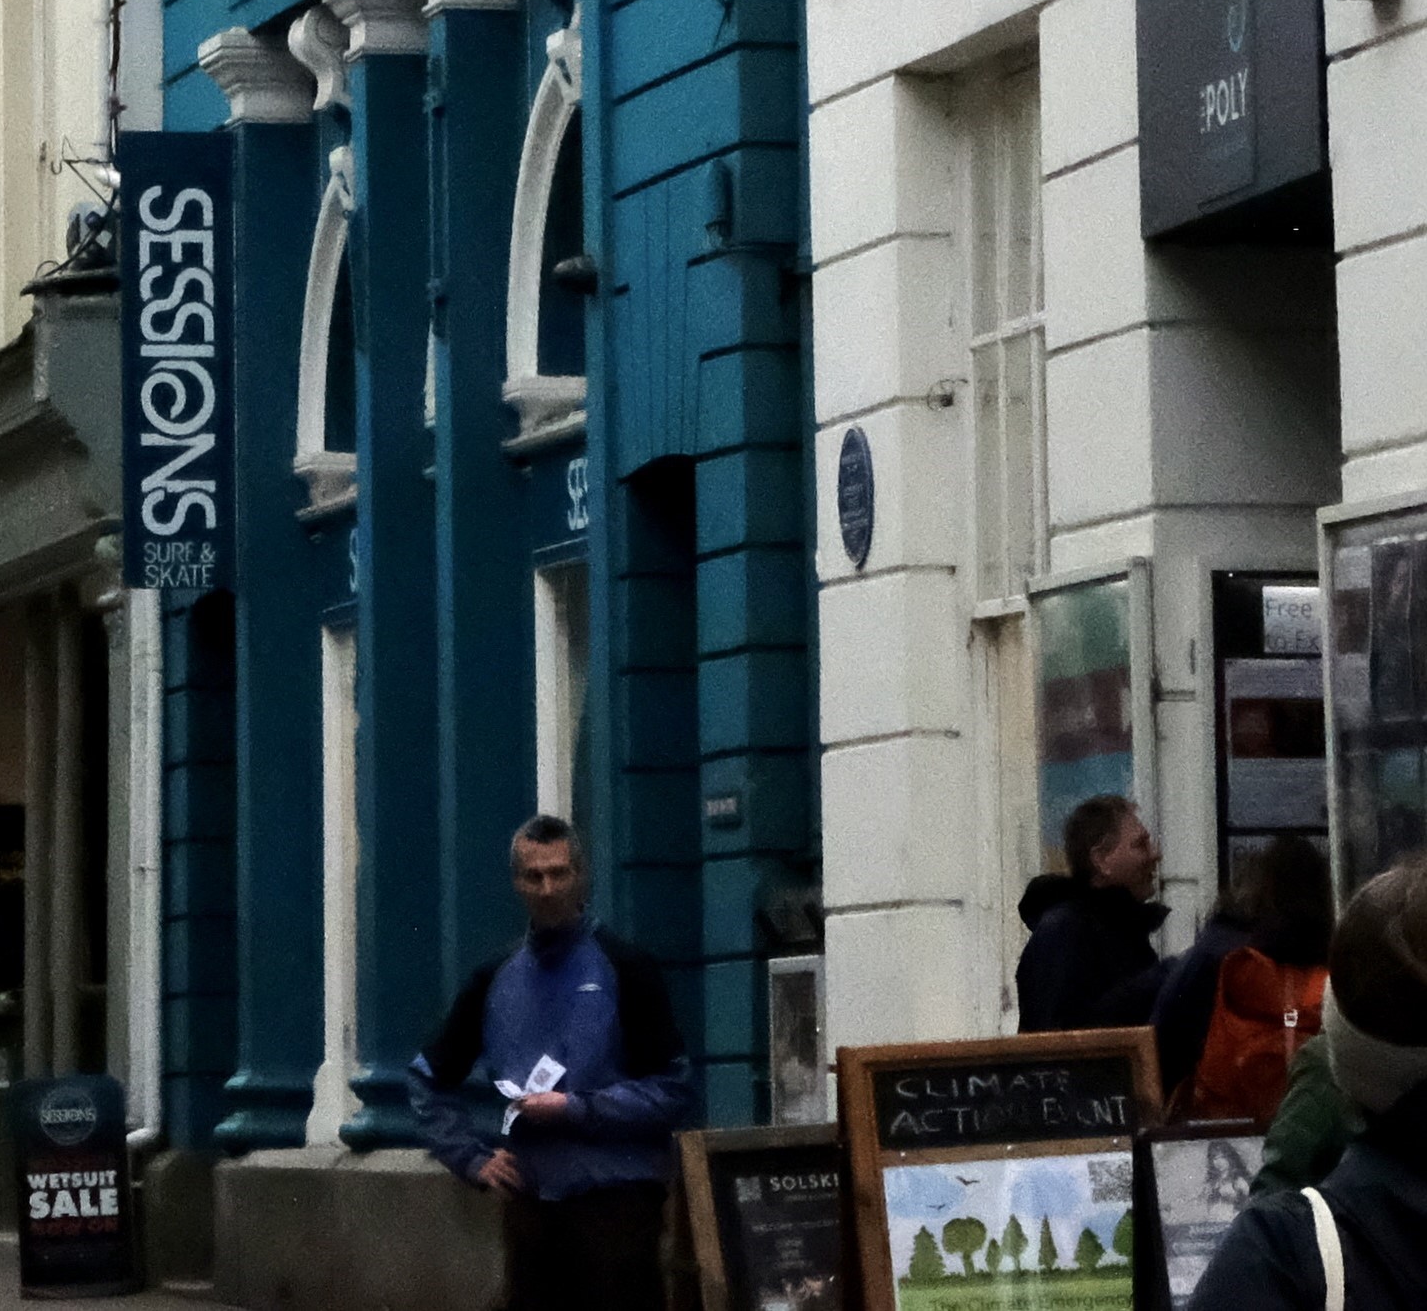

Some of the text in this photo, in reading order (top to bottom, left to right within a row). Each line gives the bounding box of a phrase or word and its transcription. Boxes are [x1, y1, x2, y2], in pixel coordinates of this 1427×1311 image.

[1205, 67, 1249, 132] POLY
[138, 185, 217, 536] SESSIONS
[143, 540, 217, 564] SURF &
[144, 564, 215, 589] SKATE
[1265, 597, 1313, 619] Free
[27, 1169, 117, 1189] WETSUIT
[28, 1188, 119, 1219] SALE
